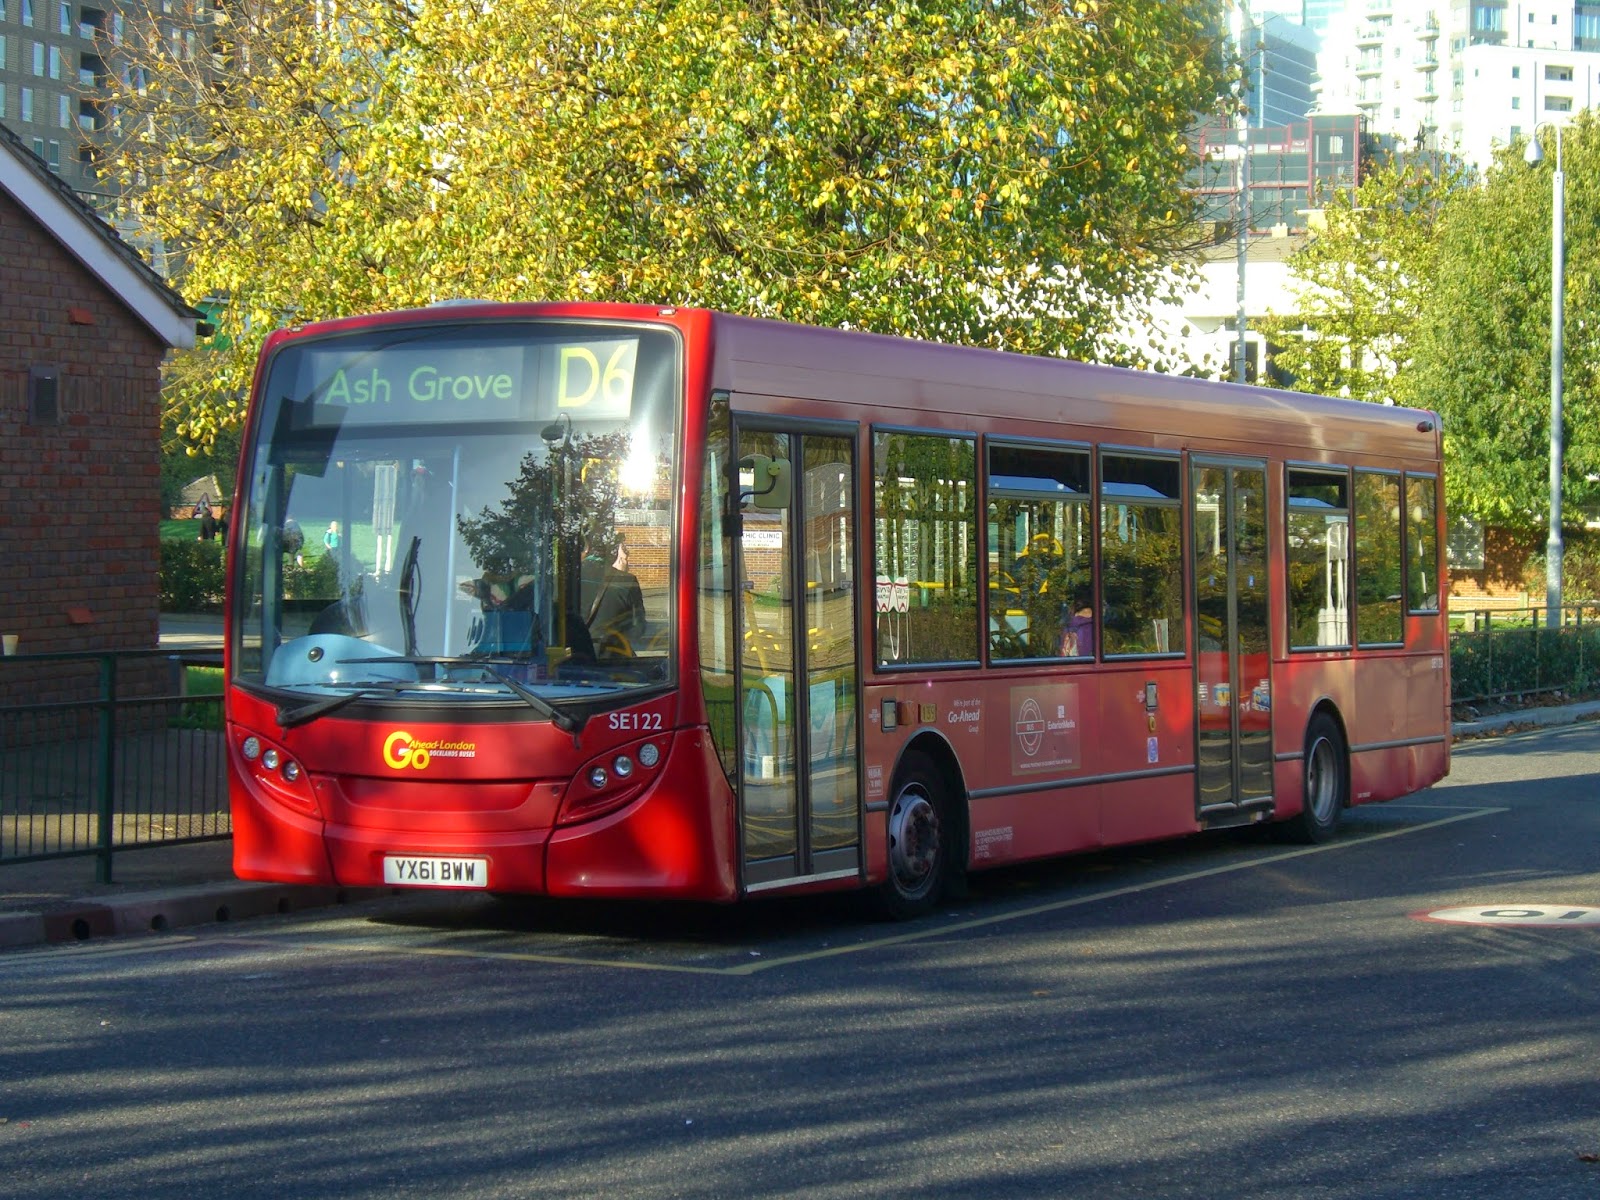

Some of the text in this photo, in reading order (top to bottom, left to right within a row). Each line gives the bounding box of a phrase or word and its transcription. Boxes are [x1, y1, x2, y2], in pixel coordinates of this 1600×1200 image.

[324, 366, 513, 404] Ash Grove
[558, 344, 632, 408] D6
[609, 713, 662, 730] SE122
[948, 709, 980, 723] Go-Ahead
[383, 731, 430, 769] Go
[429, 749, 459, 757] DOCKLANDS
[395, 859, 475, 881] YX61 BWW
